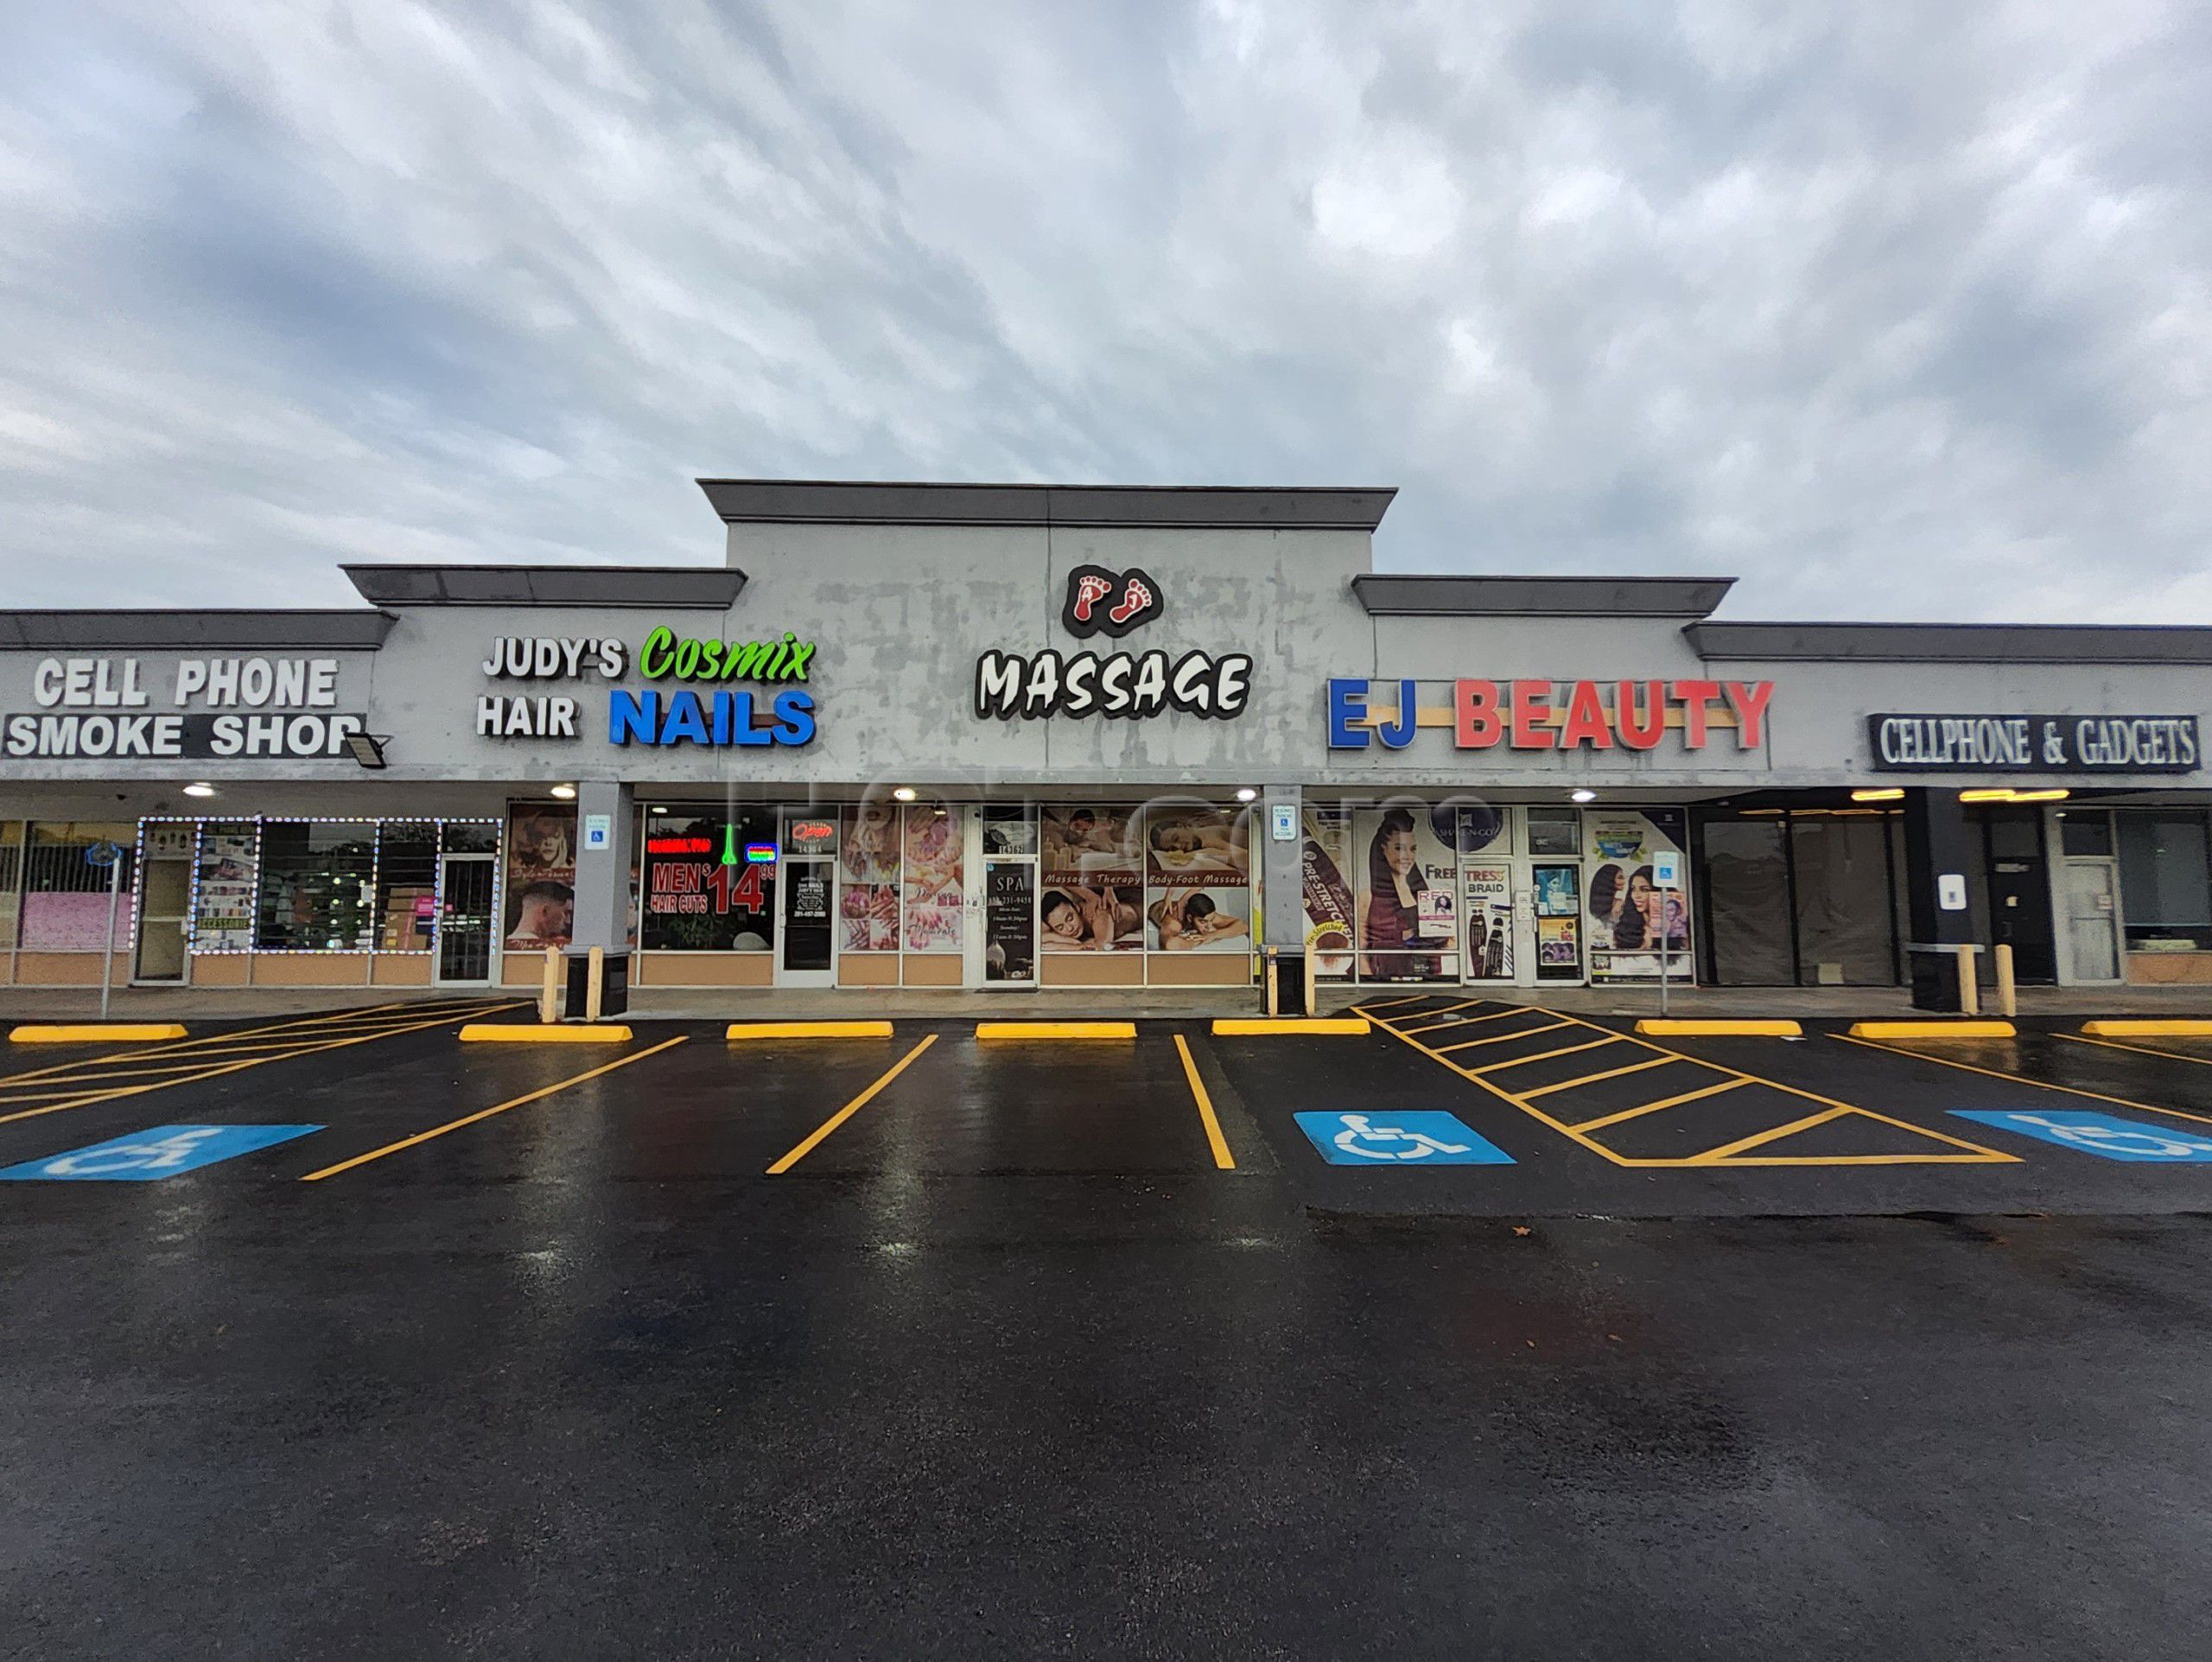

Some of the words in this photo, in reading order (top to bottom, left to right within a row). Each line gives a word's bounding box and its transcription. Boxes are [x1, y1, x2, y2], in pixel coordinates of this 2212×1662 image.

[482, 637, 624, 678] JUDY'S
[639, 625, 816, 680] Cosmix
[35, 658, 149, 707] CELL
[175, 658, 340, 708] PHONE
[980, 653, 1249, 711] MASSAGE
[477, 695, 577, 736] HAIR
[608, 690, 817, 746] NAILS
[1327, 678, 1417, 748] EJ
[1455, 678, 1775, 749] BEAUTY
[7, 716, 184, 755] SMOKE
[210, 716, 362, 755] SHOP
[1880, 717, 2032, 765] CELLPHONE
[2043, 721, 2069, 764] &
[2077, 719, 2195, 766] GADGETS
[1439, 828, 1494, 837] SHE-N-GO
[652, 863, 701, 893] MEN
[997, 876, 1025, 892] SPA
[1045, 874, 1090, 884] Massage
[1096, 874, 1141, 885] Therapy
[1148, 875, 1199, 884] Body-Foot
[1203, 874, 1248, 884] Massage
[1469, 883, 1504, 894] BRAID
[651, 895, 677, 914] HAIR
[678, 895, 709, 914] CUTS
[1419, 891, 1453, 901] RED
[197, 919, 251, 929] ACCESSORIE
